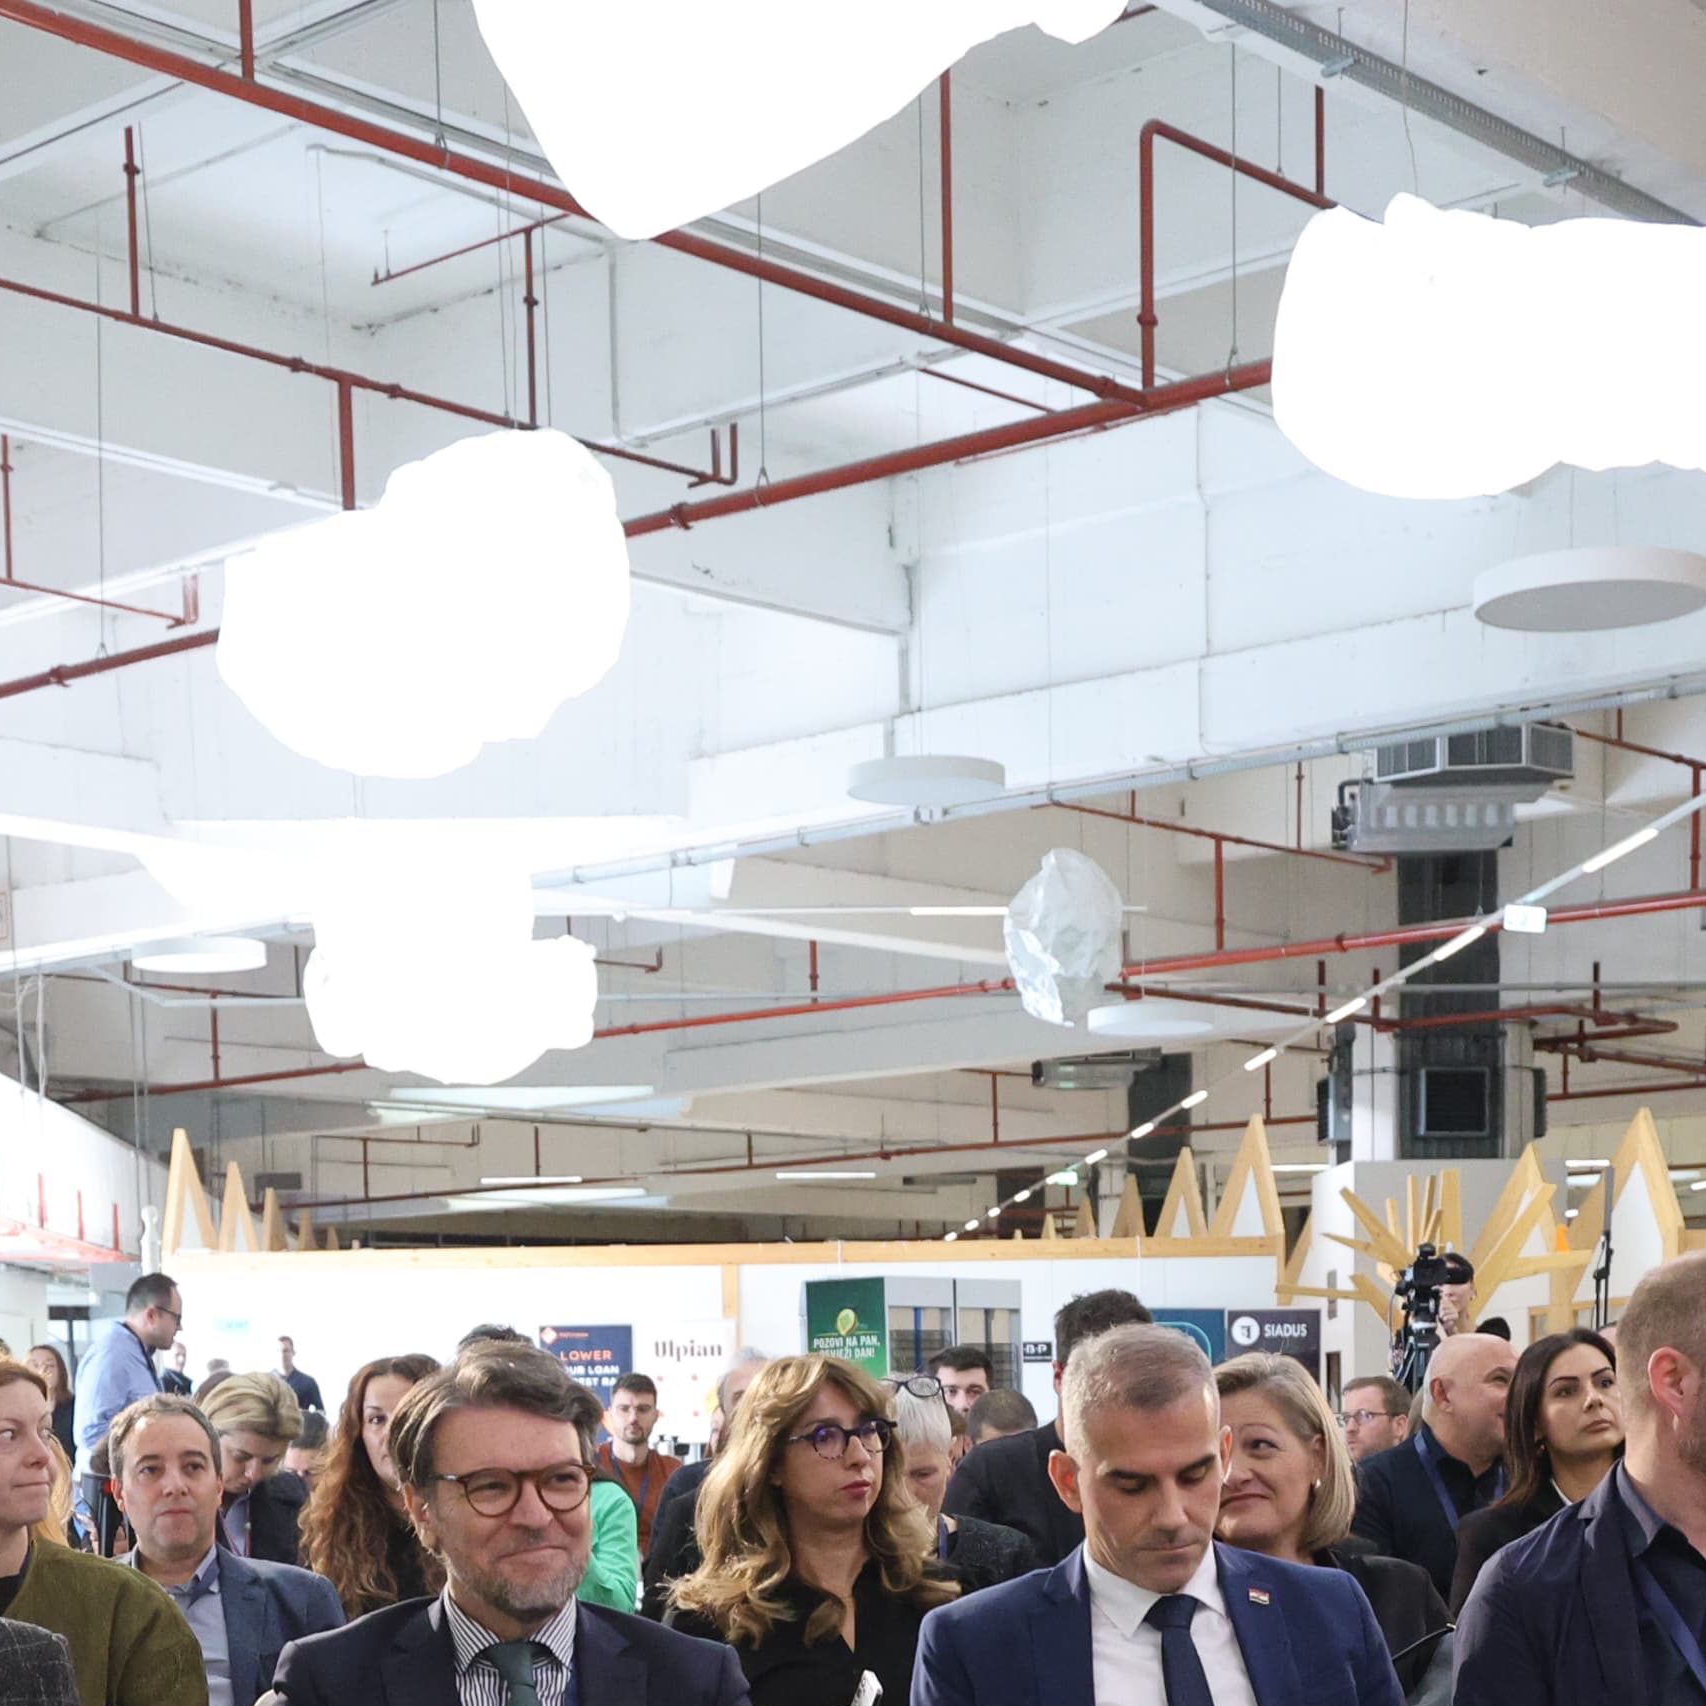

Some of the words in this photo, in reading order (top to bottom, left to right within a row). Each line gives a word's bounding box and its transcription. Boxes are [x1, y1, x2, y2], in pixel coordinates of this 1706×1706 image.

[1264, 1323, 1307, 1338] SIADUS
[813, 1336, 843, 1349] POZOVI
[846, 1335, 858, 1347] NA
[560, 1349, 613, 1361] LOWER
[654, 1339, 722, 1362] Ulpian
[854, 1347, 875, 1359] DAN!
[588, 1364, 620, 1374] LOAN
